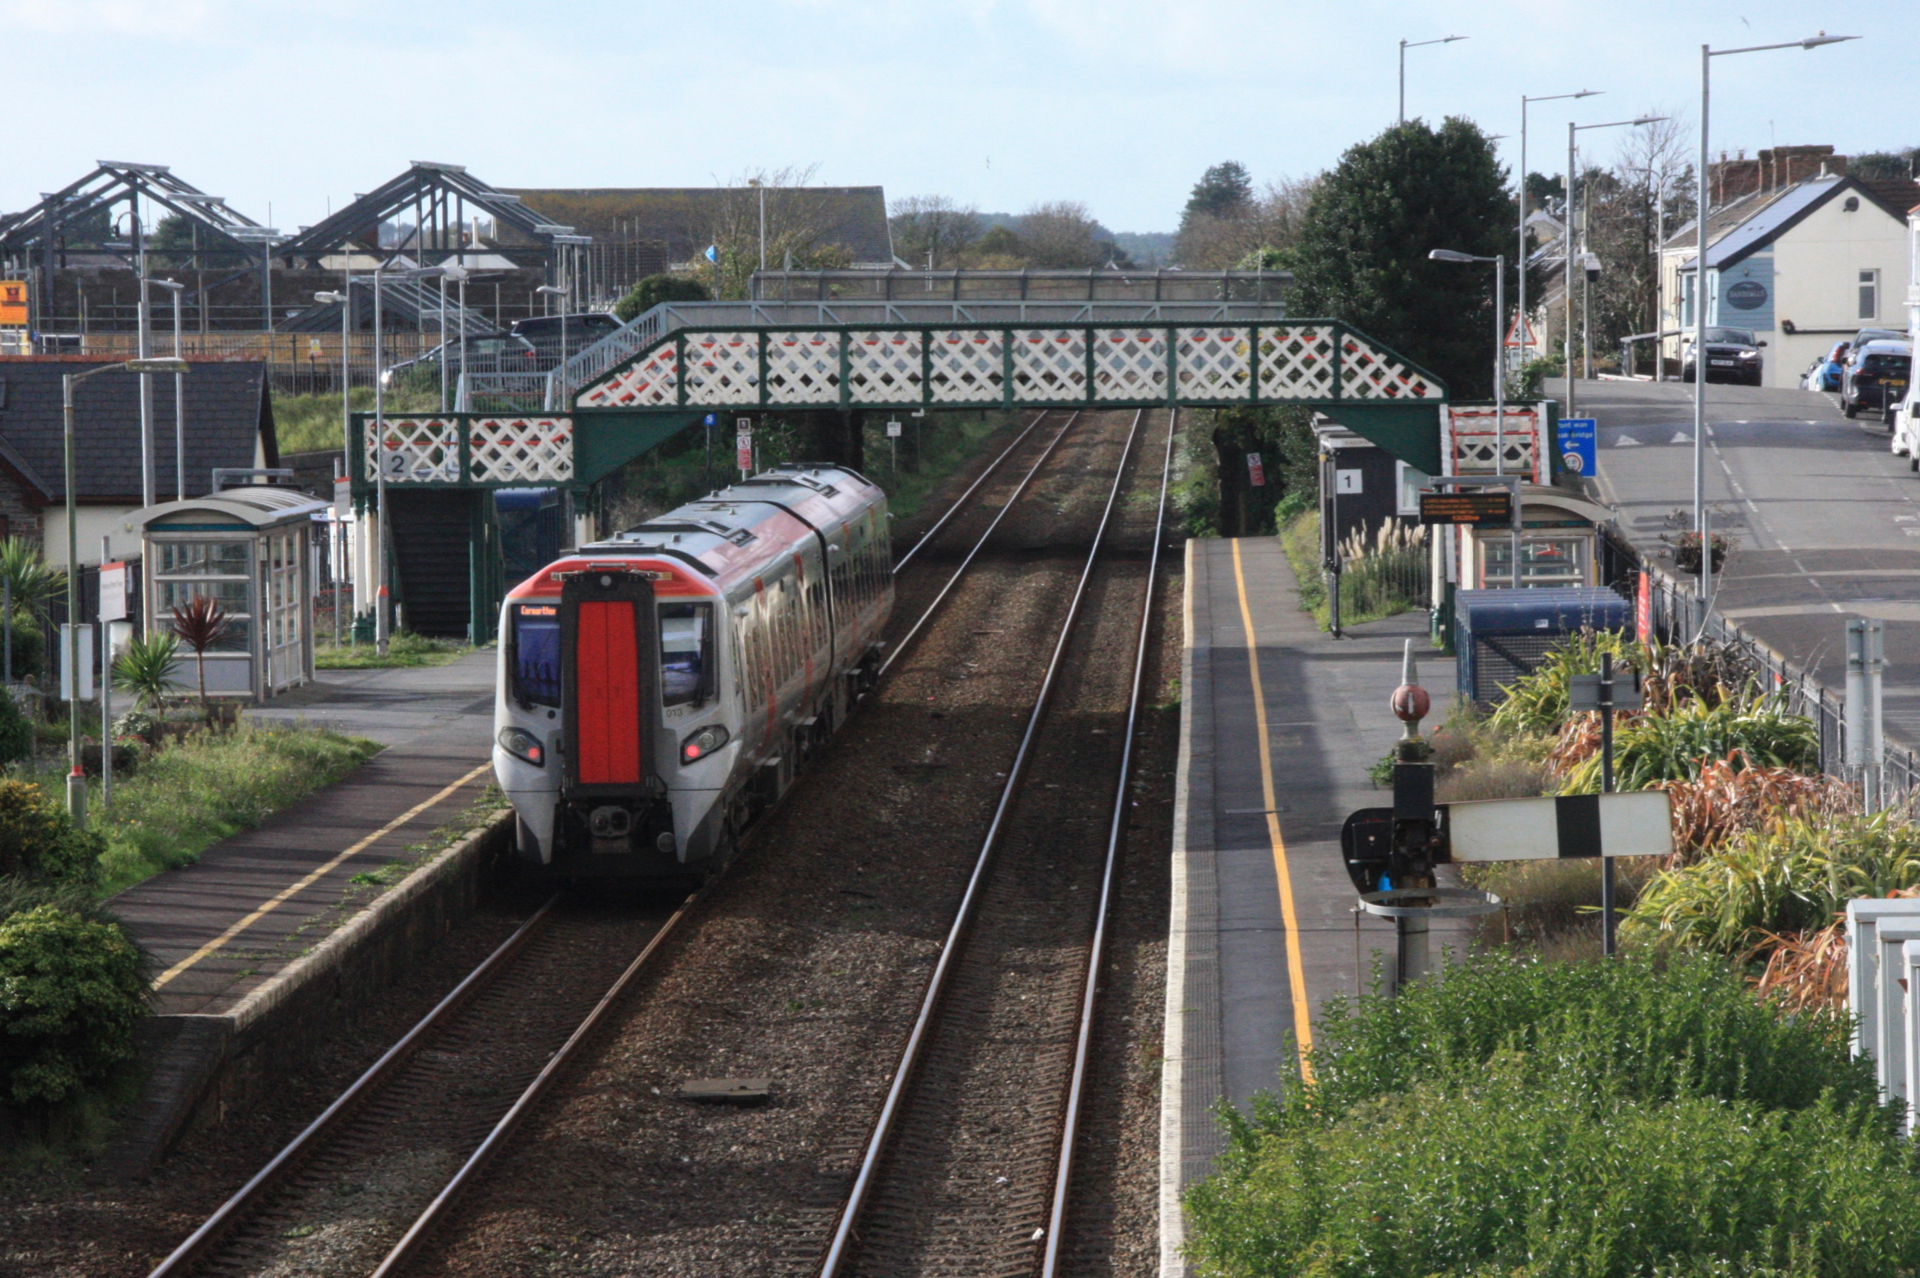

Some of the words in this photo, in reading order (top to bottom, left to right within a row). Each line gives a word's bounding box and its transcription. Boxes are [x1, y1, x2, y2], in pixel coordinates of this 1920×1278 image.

[706, 414, 713, 423] S
[1571, 431, 1593, 439] bridge
[391, 455, 404, 473] 2
[1344, 475, 1351, 488] 1
[666, 708, 683, 718] 013
